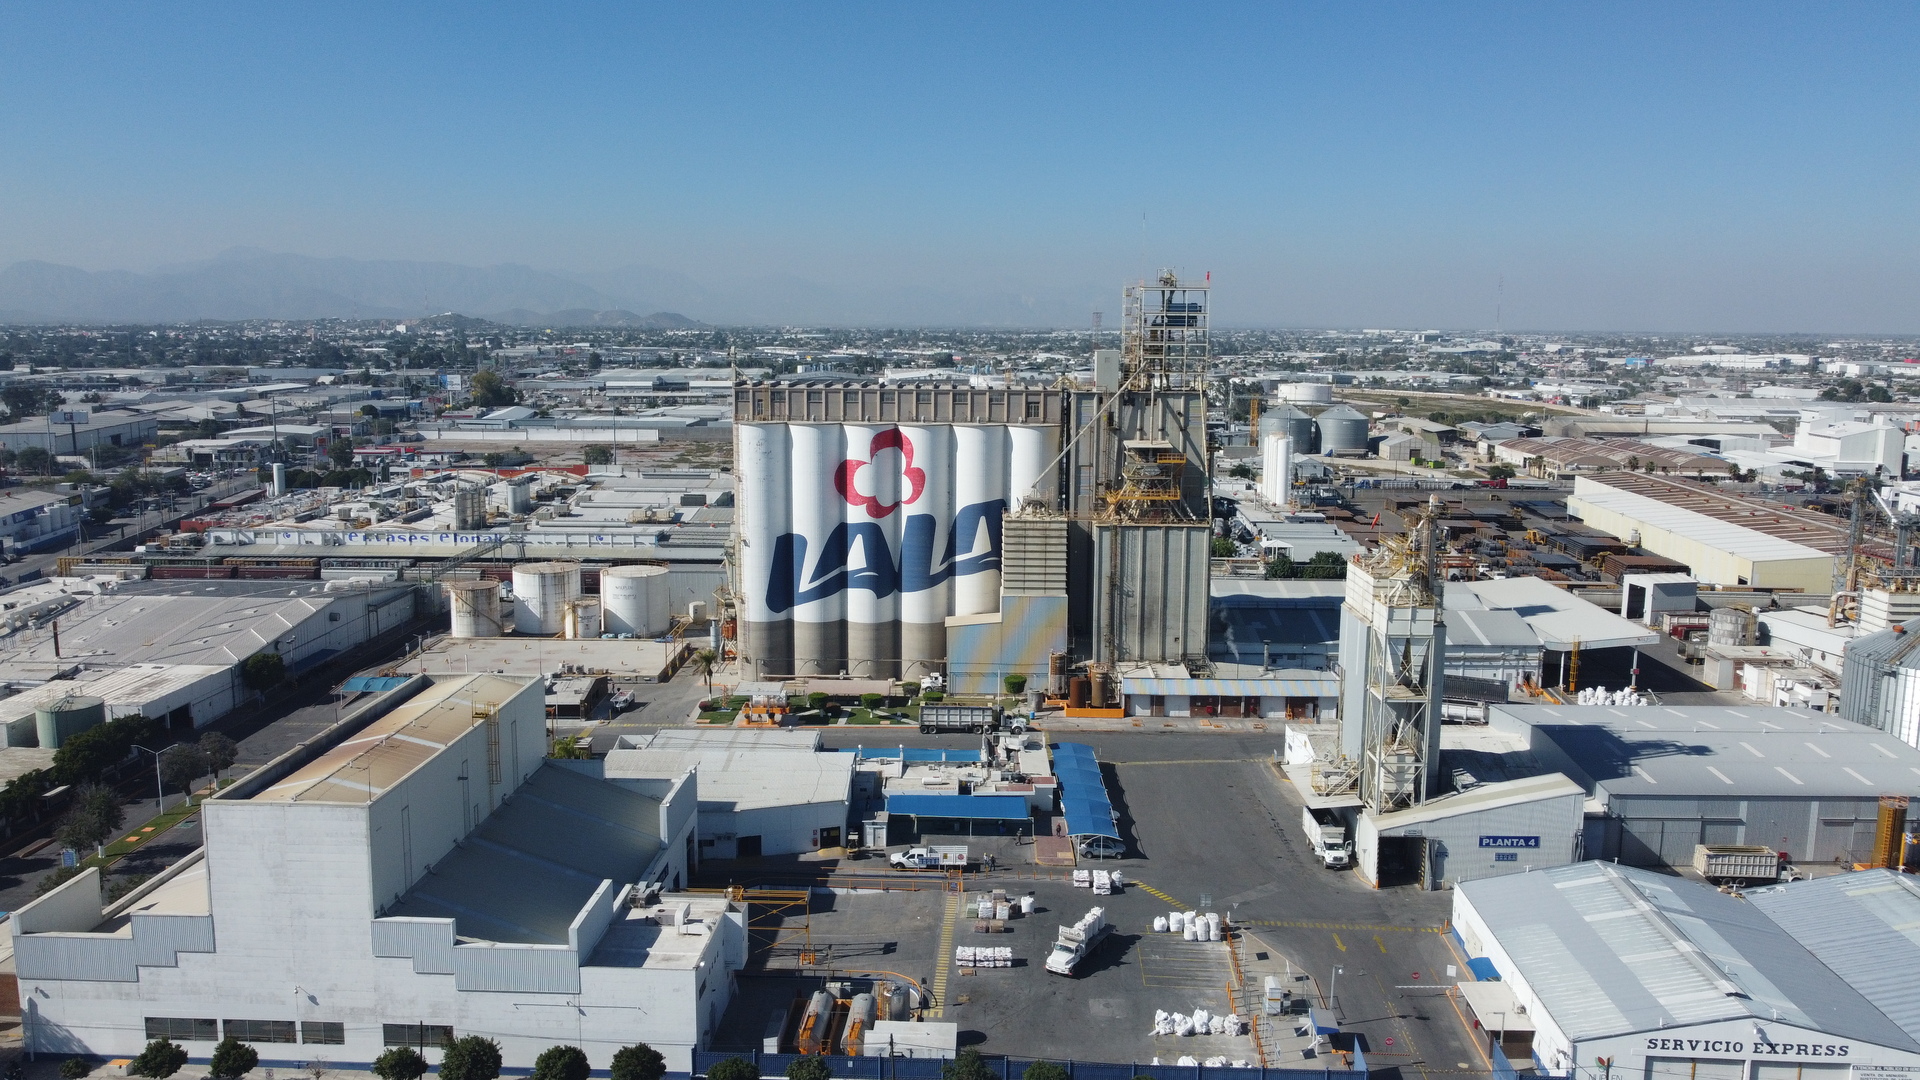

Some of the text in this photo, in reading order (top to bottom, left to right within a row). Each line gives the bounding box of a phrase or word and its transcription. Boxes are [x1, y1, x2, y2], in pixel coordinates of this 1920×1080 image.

[766, 499, 1006, 613] LALA
[1482, 838, 1535, 846] PLANTA 4
[1647, 1038, 1850, 1057] SERVICIO EXPRESS
